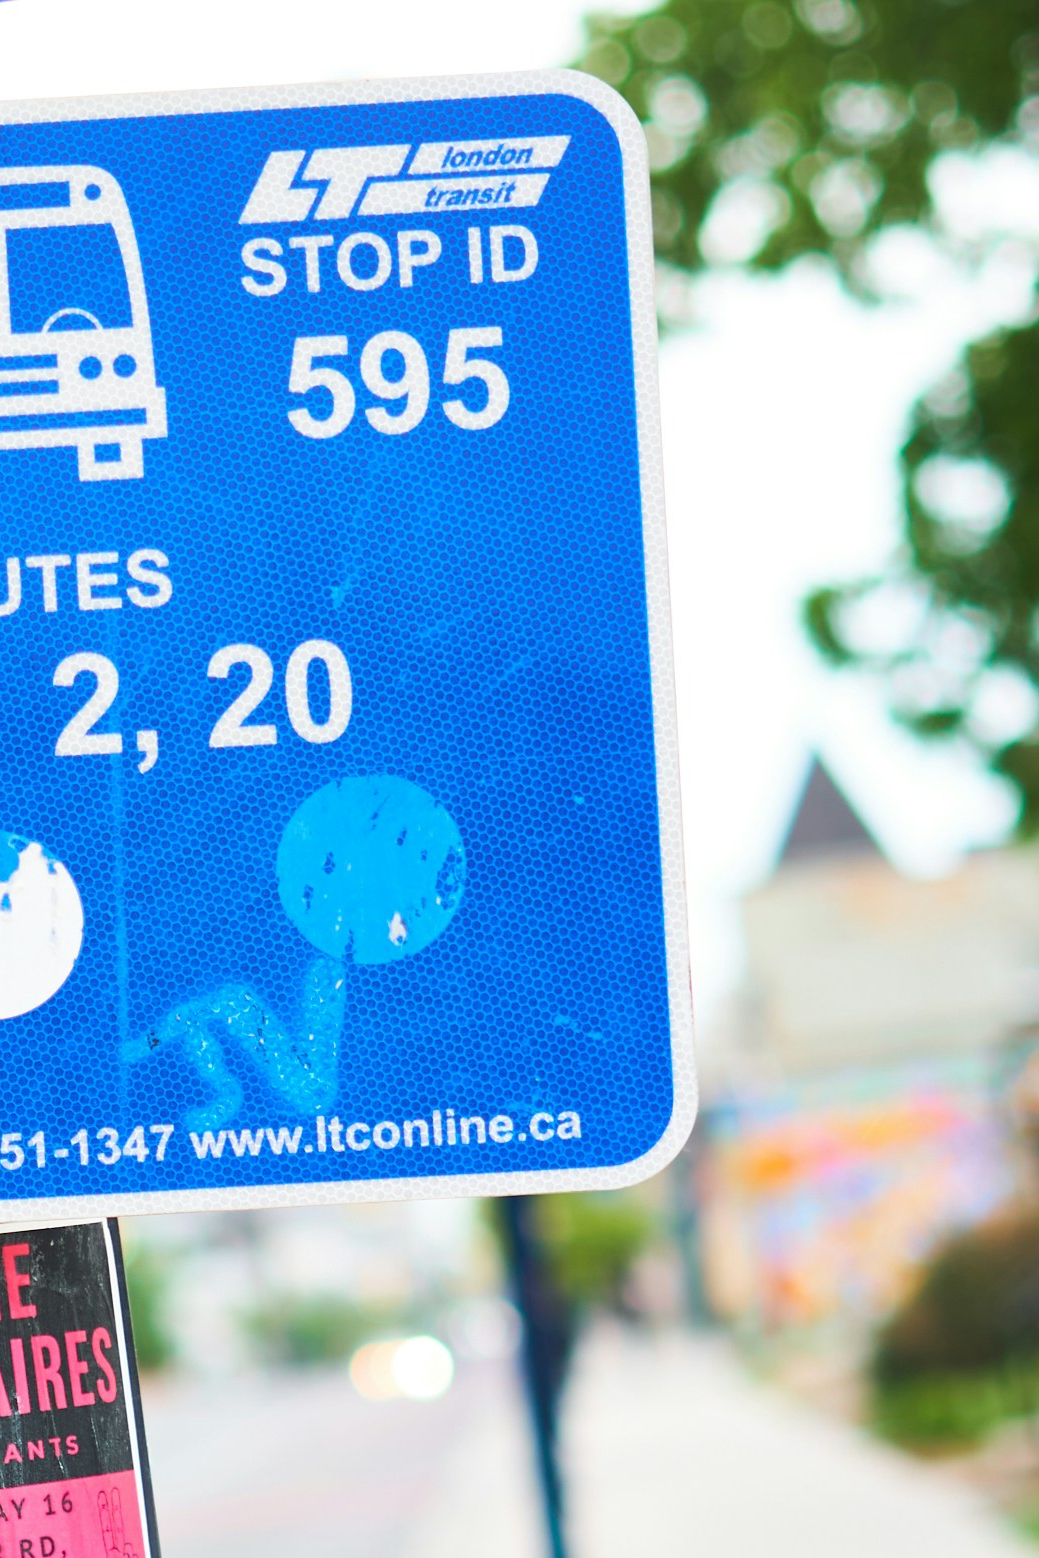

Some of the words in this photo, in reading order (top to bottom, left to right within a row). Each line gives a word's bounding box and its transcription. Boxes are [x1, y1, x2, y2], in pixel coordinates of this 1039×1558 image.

[442, 144, 533, 169] london
[424, 182, 517, 208] transit
[241, 230, 442, 296] STOP
[468, 225, 539, 284] ID
[287, 326, 511, 439] 595
[52, 652, 159, 774] 2,
[207, 639, 353, 748] 20
[190, 1110, 582, 1159] www.ltconline.ca
[43, 1492, 73, 1516] 16
